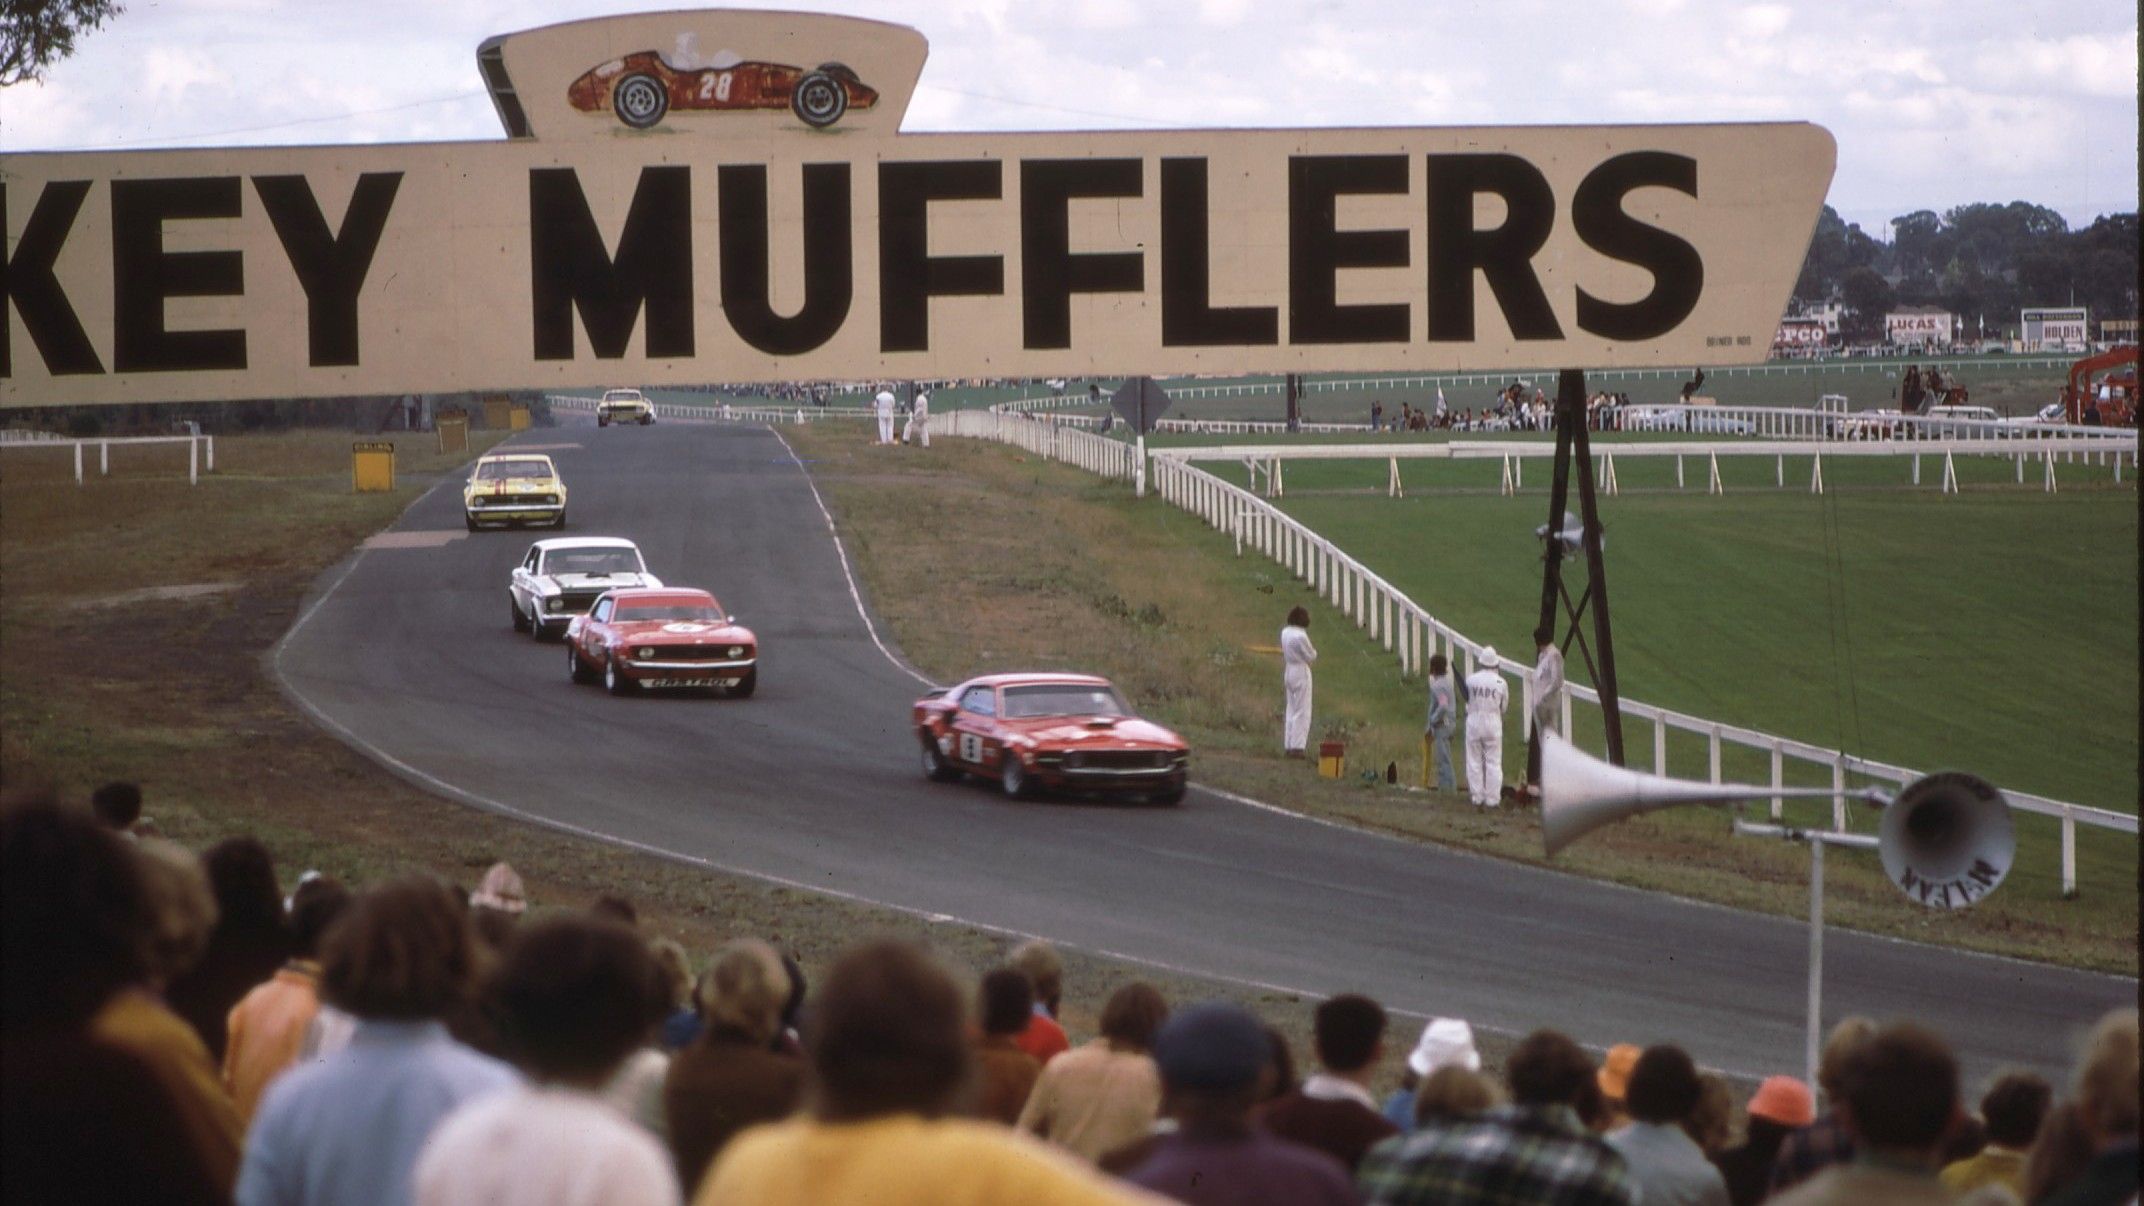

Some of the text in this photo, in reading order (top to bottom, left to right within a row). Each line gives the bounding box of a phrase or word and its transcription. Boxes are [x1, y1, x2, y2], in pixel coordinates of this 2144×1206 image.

[700, 73, 733, 101] 28
[0, 151, 1704, 378] KEY MUFFLERS
[1888, 319, 1936, 330] LUCAS
[2044, 325, 2082, 339] HOLDEN
